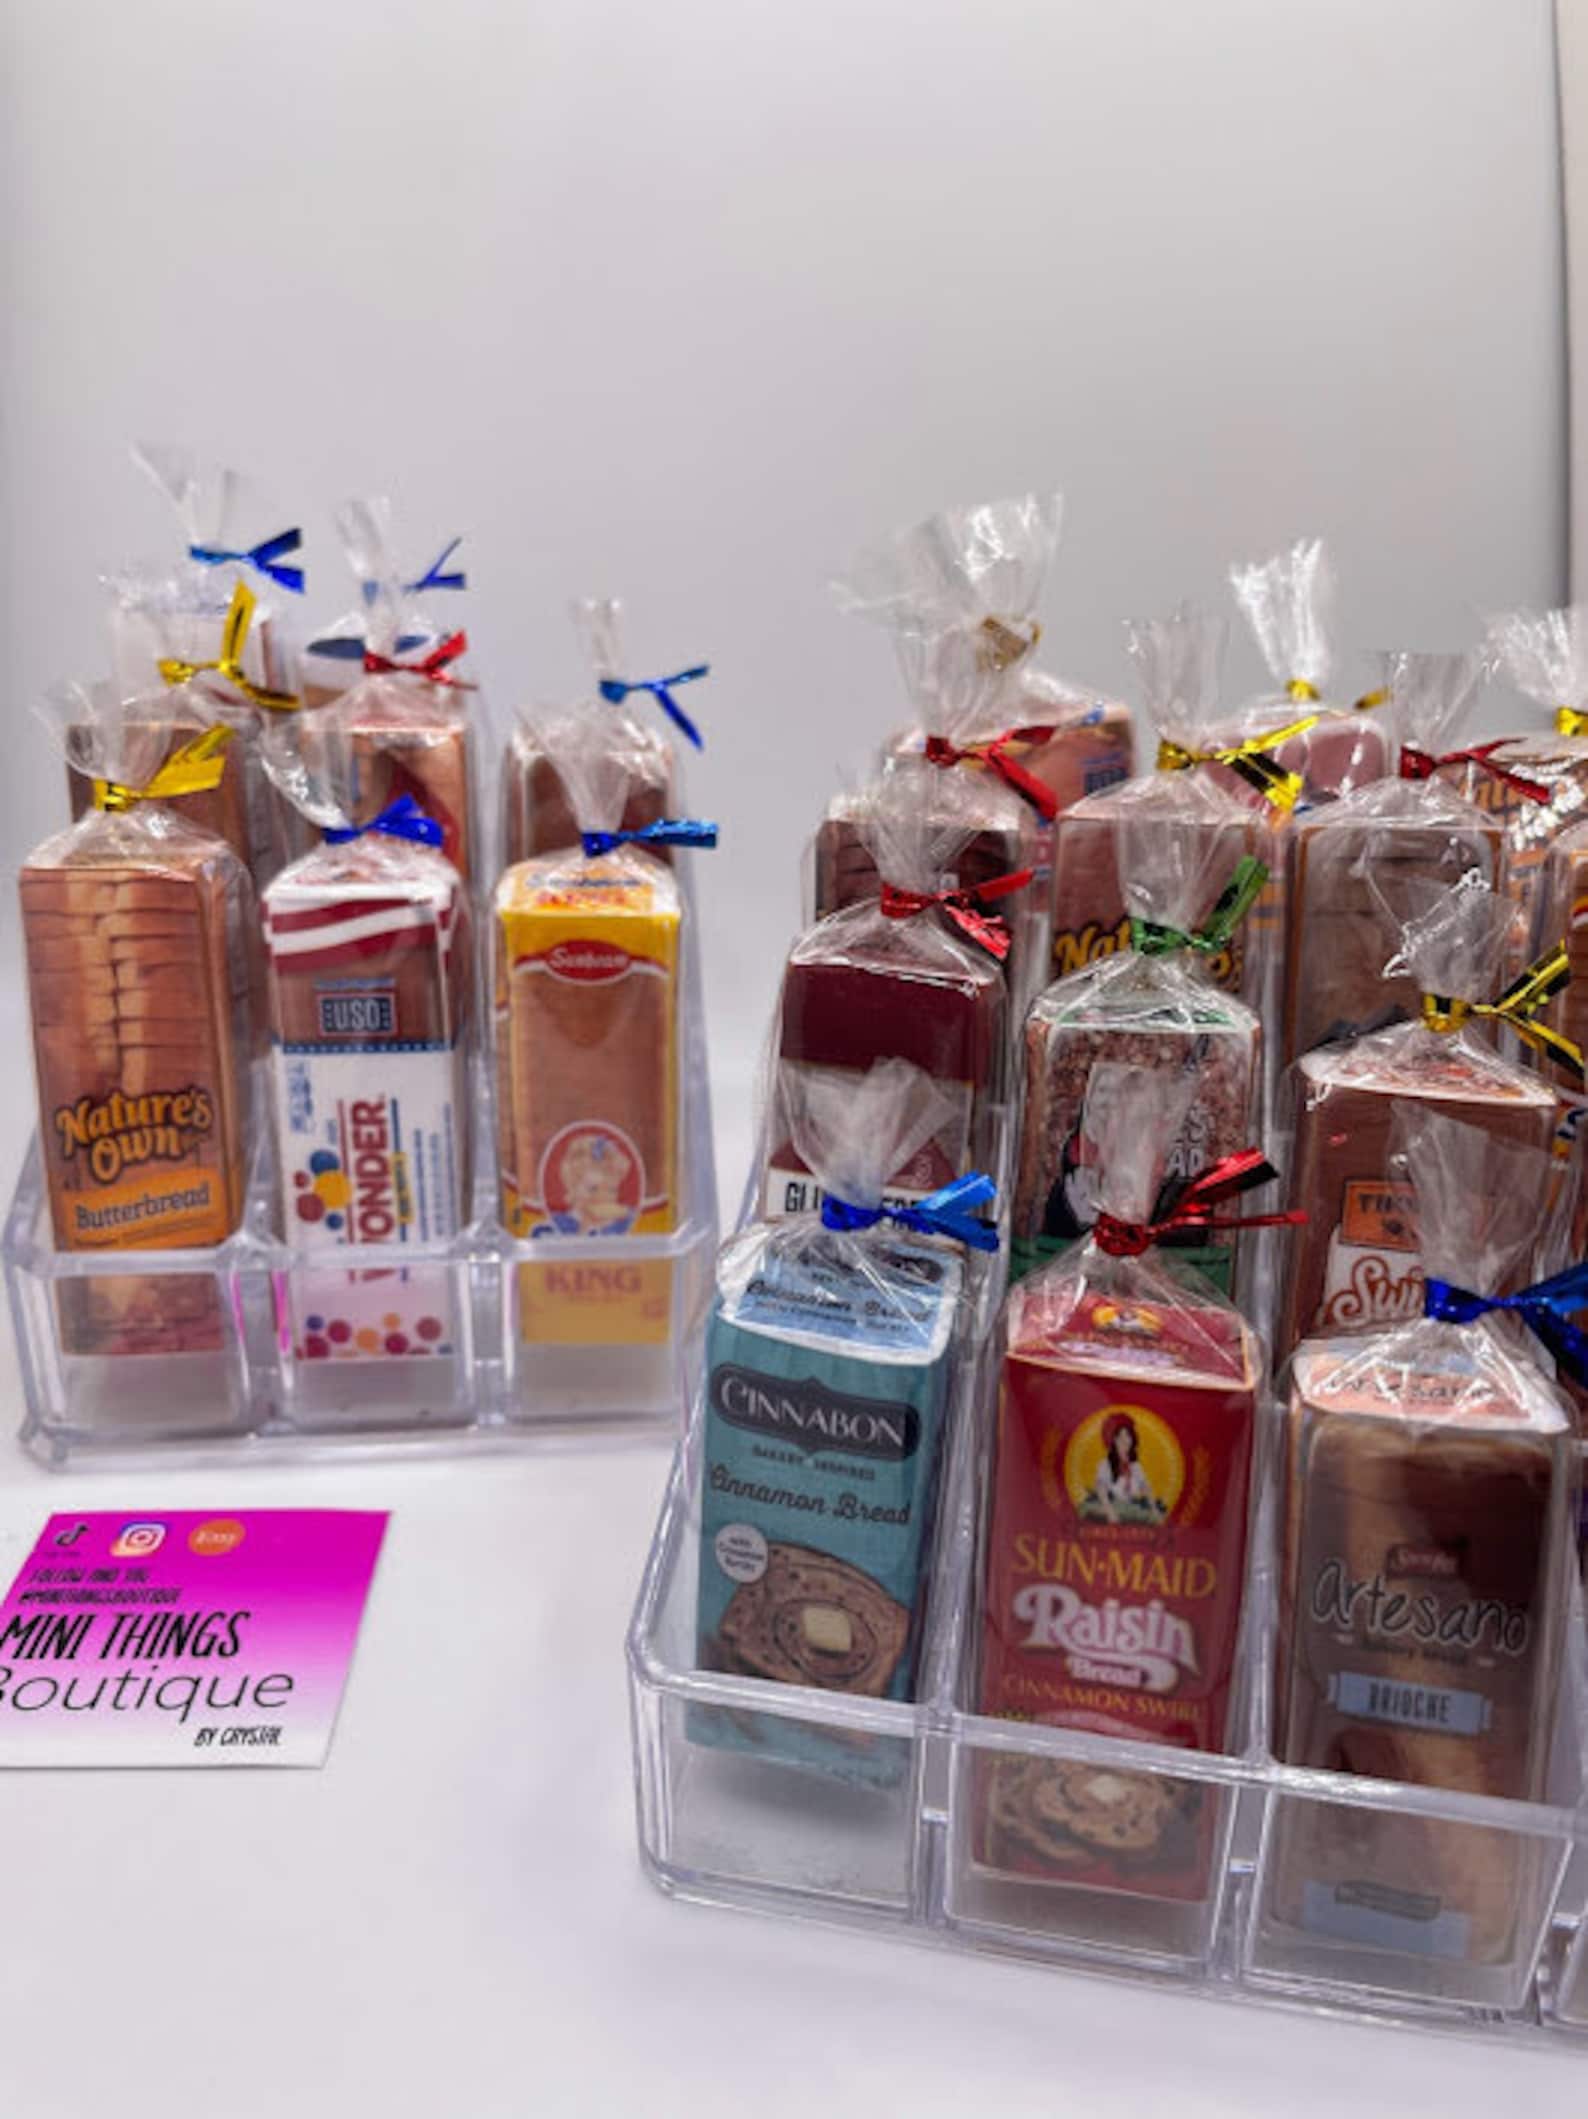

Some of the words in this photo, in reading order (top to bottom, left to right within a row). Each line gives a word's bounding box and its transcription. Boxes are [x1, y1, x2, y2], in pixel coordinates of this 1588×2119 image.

[334, 998, 382, 1030] USO
[55, 1086, 215, 1159] Nature's
[89, 1125, 184, 1185] Own
[75, 1181, 211, 1229] Butterbread
[544, 1264, 642, 1294] KING
[720, 1376, 904, 1448] CINNABON
[710, 1463, 827, 1514] Cinnamon
[831, 1491, 912, 1525] Bread
[0, 1612, 97, 1661] MINI
[100, 1611, 251, 1660] THINGS
[1012, 1582, 1201, 1676] Raisin
[1002, 1673, 1129, 1712] CINNAMON
[1367, 1683, 1450, 1724] BRIOCHE
[194, 1727, 218, 1747] BY
